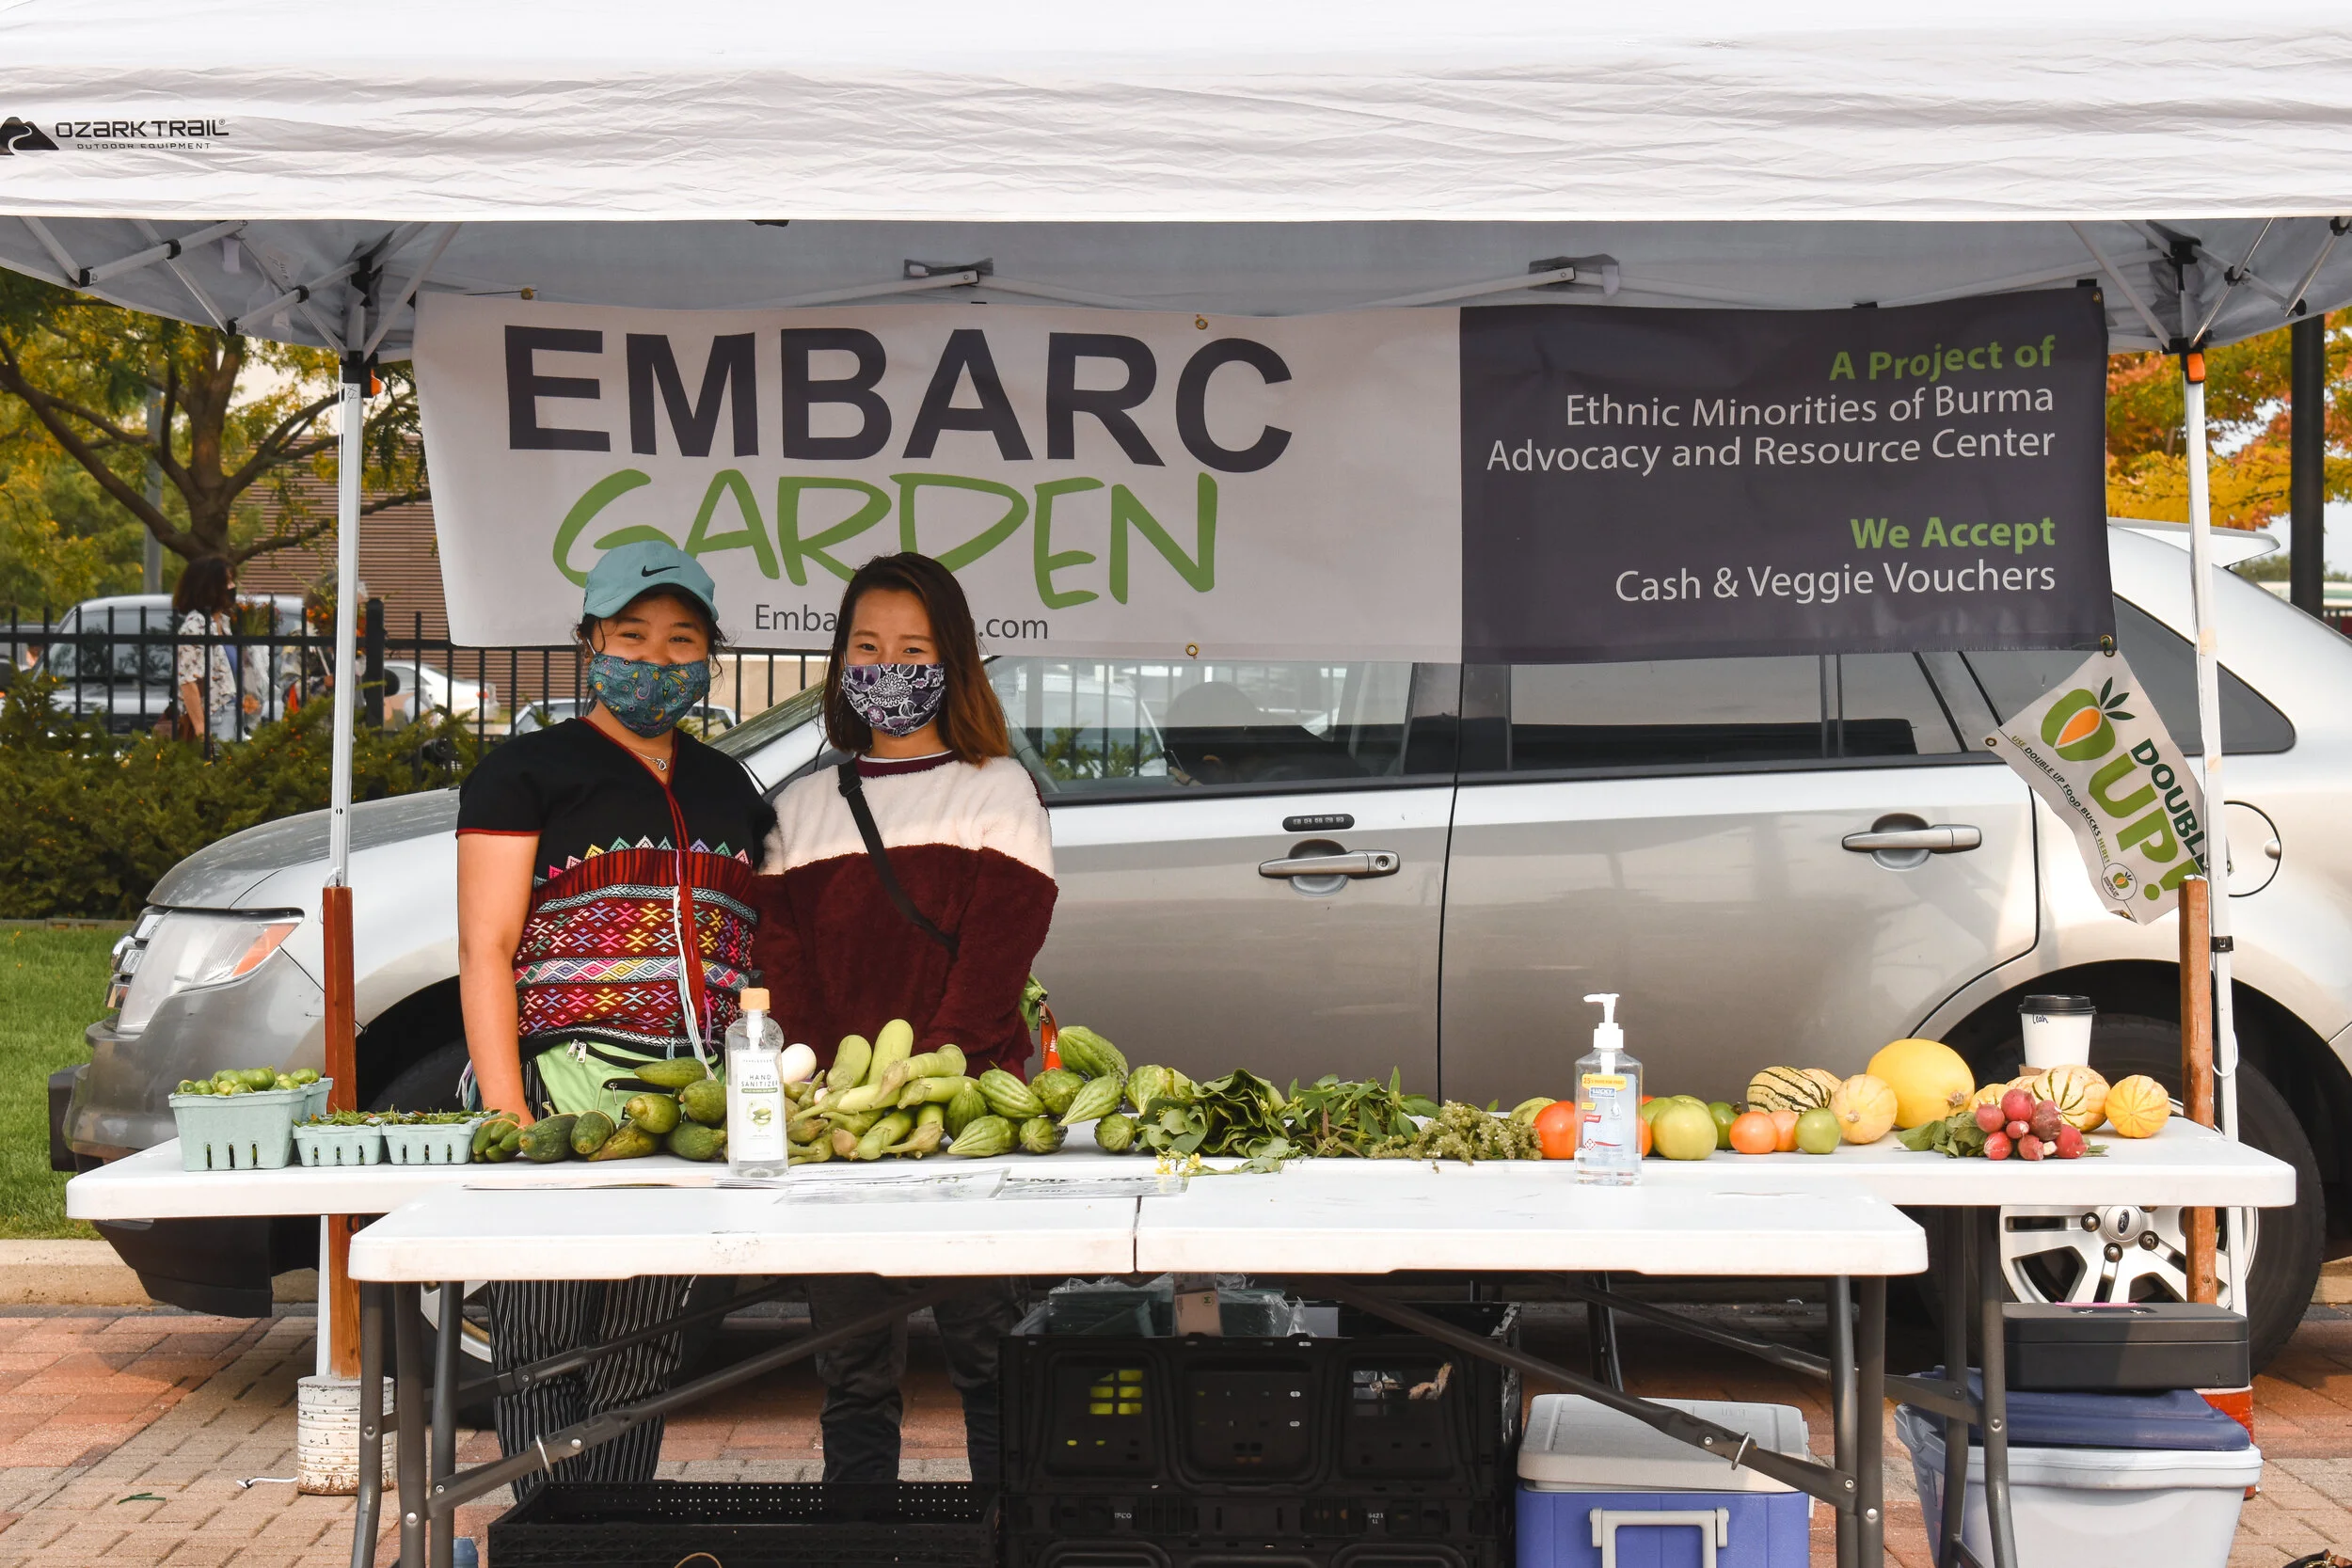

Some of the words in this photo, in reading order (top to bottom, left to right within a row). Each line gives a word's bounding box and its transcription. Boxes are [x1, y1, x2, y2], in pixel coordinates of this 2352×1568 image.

[1830, 351, 1856, 380] A
[1869, 342, 2002, 382] Project
[2014, 335, 2055, 368] of
[504, 325, 1293, 473] EMBARC
[1567, 394, 1680, 426] Ethnic
[1693, 394, 1877, 427] Minorities
[1889, 388, 1926, 420] of
[1935, 385, 2053, 416] Burma
[1487, 438, 1661, 476] Advocacy
[1672, 436, 1740, 466] and
[1755, 436, 1920, 465] Resource
[1932, 428, 2056, 458] Center
[552, 468, 1218, 610] GARDEN
[1851, 518, 1911, 548] We
[1922, 516, 2056, 553] Accept
[1615, 567, 1701, 601] Cash
[1713, 567, 1739, 598] &
[1747, 562, 1874, 604] Veggie
[1883, 558, 2056, 594] Vouchers
[2011, 736, 2026, 747] USE
[2025, 747, 2055, 774] DOUBLE
[2053, 772, 2065, 783] UP
[2063, 784, 2081, 808] FOOD
[2080, 807, 2101, 836] BUCKS
[2097, 838, 2110, 863] HERE!
